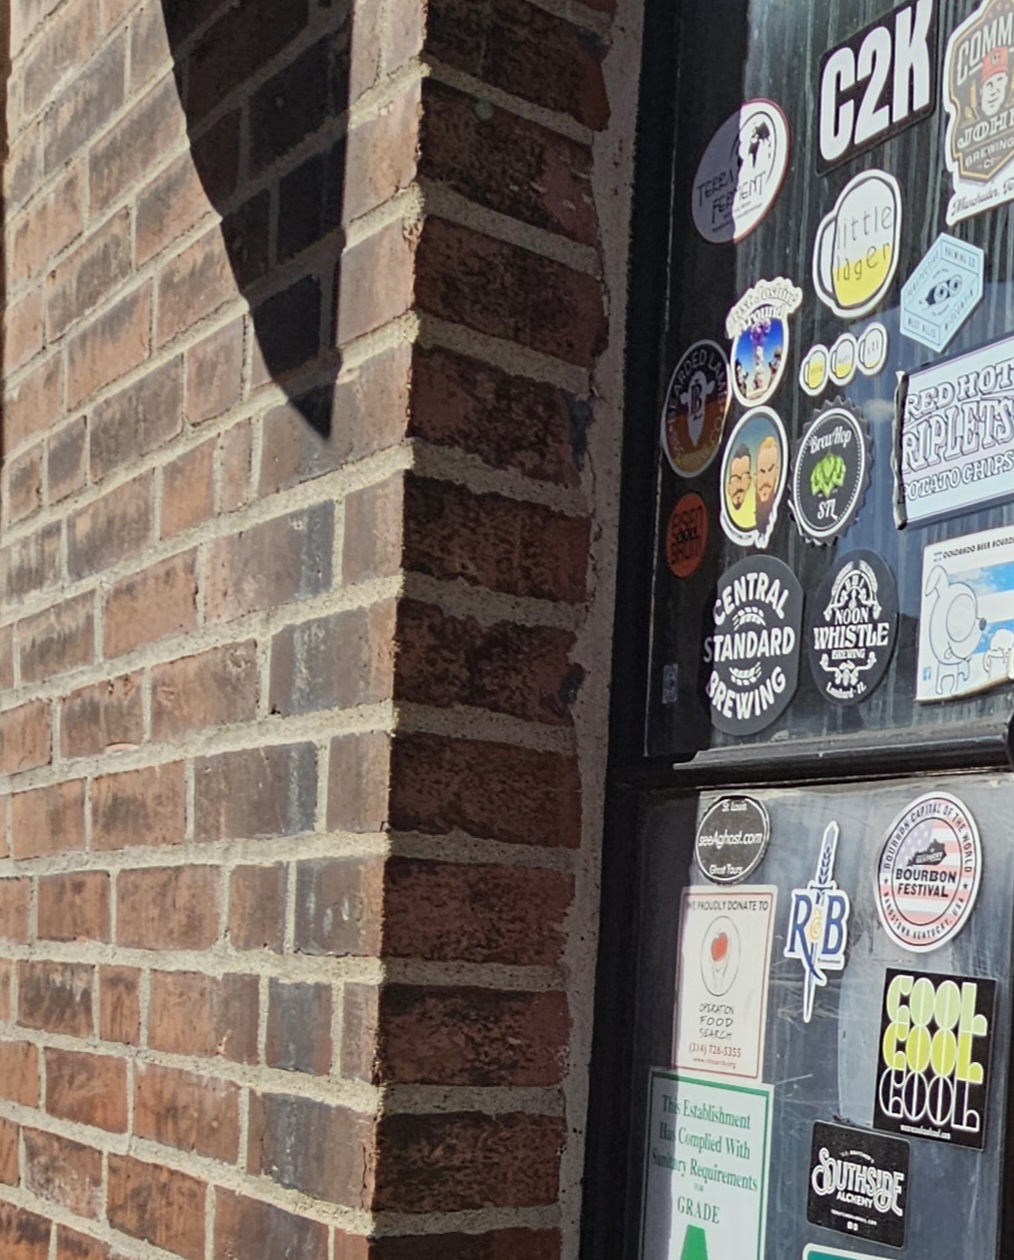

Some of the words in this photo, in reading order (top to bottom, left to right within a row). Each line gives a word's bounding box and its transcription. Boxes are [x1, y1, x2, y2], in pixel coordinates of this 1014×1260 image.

[820, 0, 932, 161] C2K
[965, 136, 1014, 168] BREWING
[837, 205, 893, 250] little
[836, 242, 891, 281] lager
[905, 382, 955, 423] RED
[904, 466, 960, 501] POTATO
[960, 449, 1014, 485] CHIPS
[817, 498, 838, 519] STL
[713, 571, 789, 626] CENTRAL
[834, 606, 869, 625] NOON
[703, 626, 795, 663] STANDARD
[813, 623, 890, 650] WHISTLE
[831, 648, 866, 660] BREWING
[705, 666, 786, 720] BREWING
[884, 821, 910, 869] BOURBON
[909, 802, 941, 823] CAPITAL
[943, 805, 953, 816] OF
[950, 813, 967, 832] THE
[961, 833, 973, 873] WORLD
[895, 868, 957, 884] BOURBON
[897, 883, 949, 898] FESTIVAL
[698, 900, 726, 911] PROUDLY
[728, 900, 757, 911] DONATE
[758, 901, 769, 911] TO
[953, 897, 964, 916] USA
[699, 1016, 734, 1028] FOOD
[886, 974, 988, 1037] COOL
[699, 1028, 732, 1040] SEARCH
[882, 1021, 985, 1085] COOL
[662, 1094, 680, 1113] This
[683, 1099, 751, 1131] Establishment
[878, 1067, 981, 1133] COOL
[659, 1121, 677, 1140] Has
[678, 1126, 722, 1154] Complied
[725, 1137, 751, 1160] With
[651, 1147, 687, 1178] Sanitary
[690, 1158, 758, 1192] Requirements
[812, 1147, 905, 1216] SOUTHSIDE
[677, 1195, 720, 1225] GRADE
[836, 1191, 873, 1208] ALCHEMY
